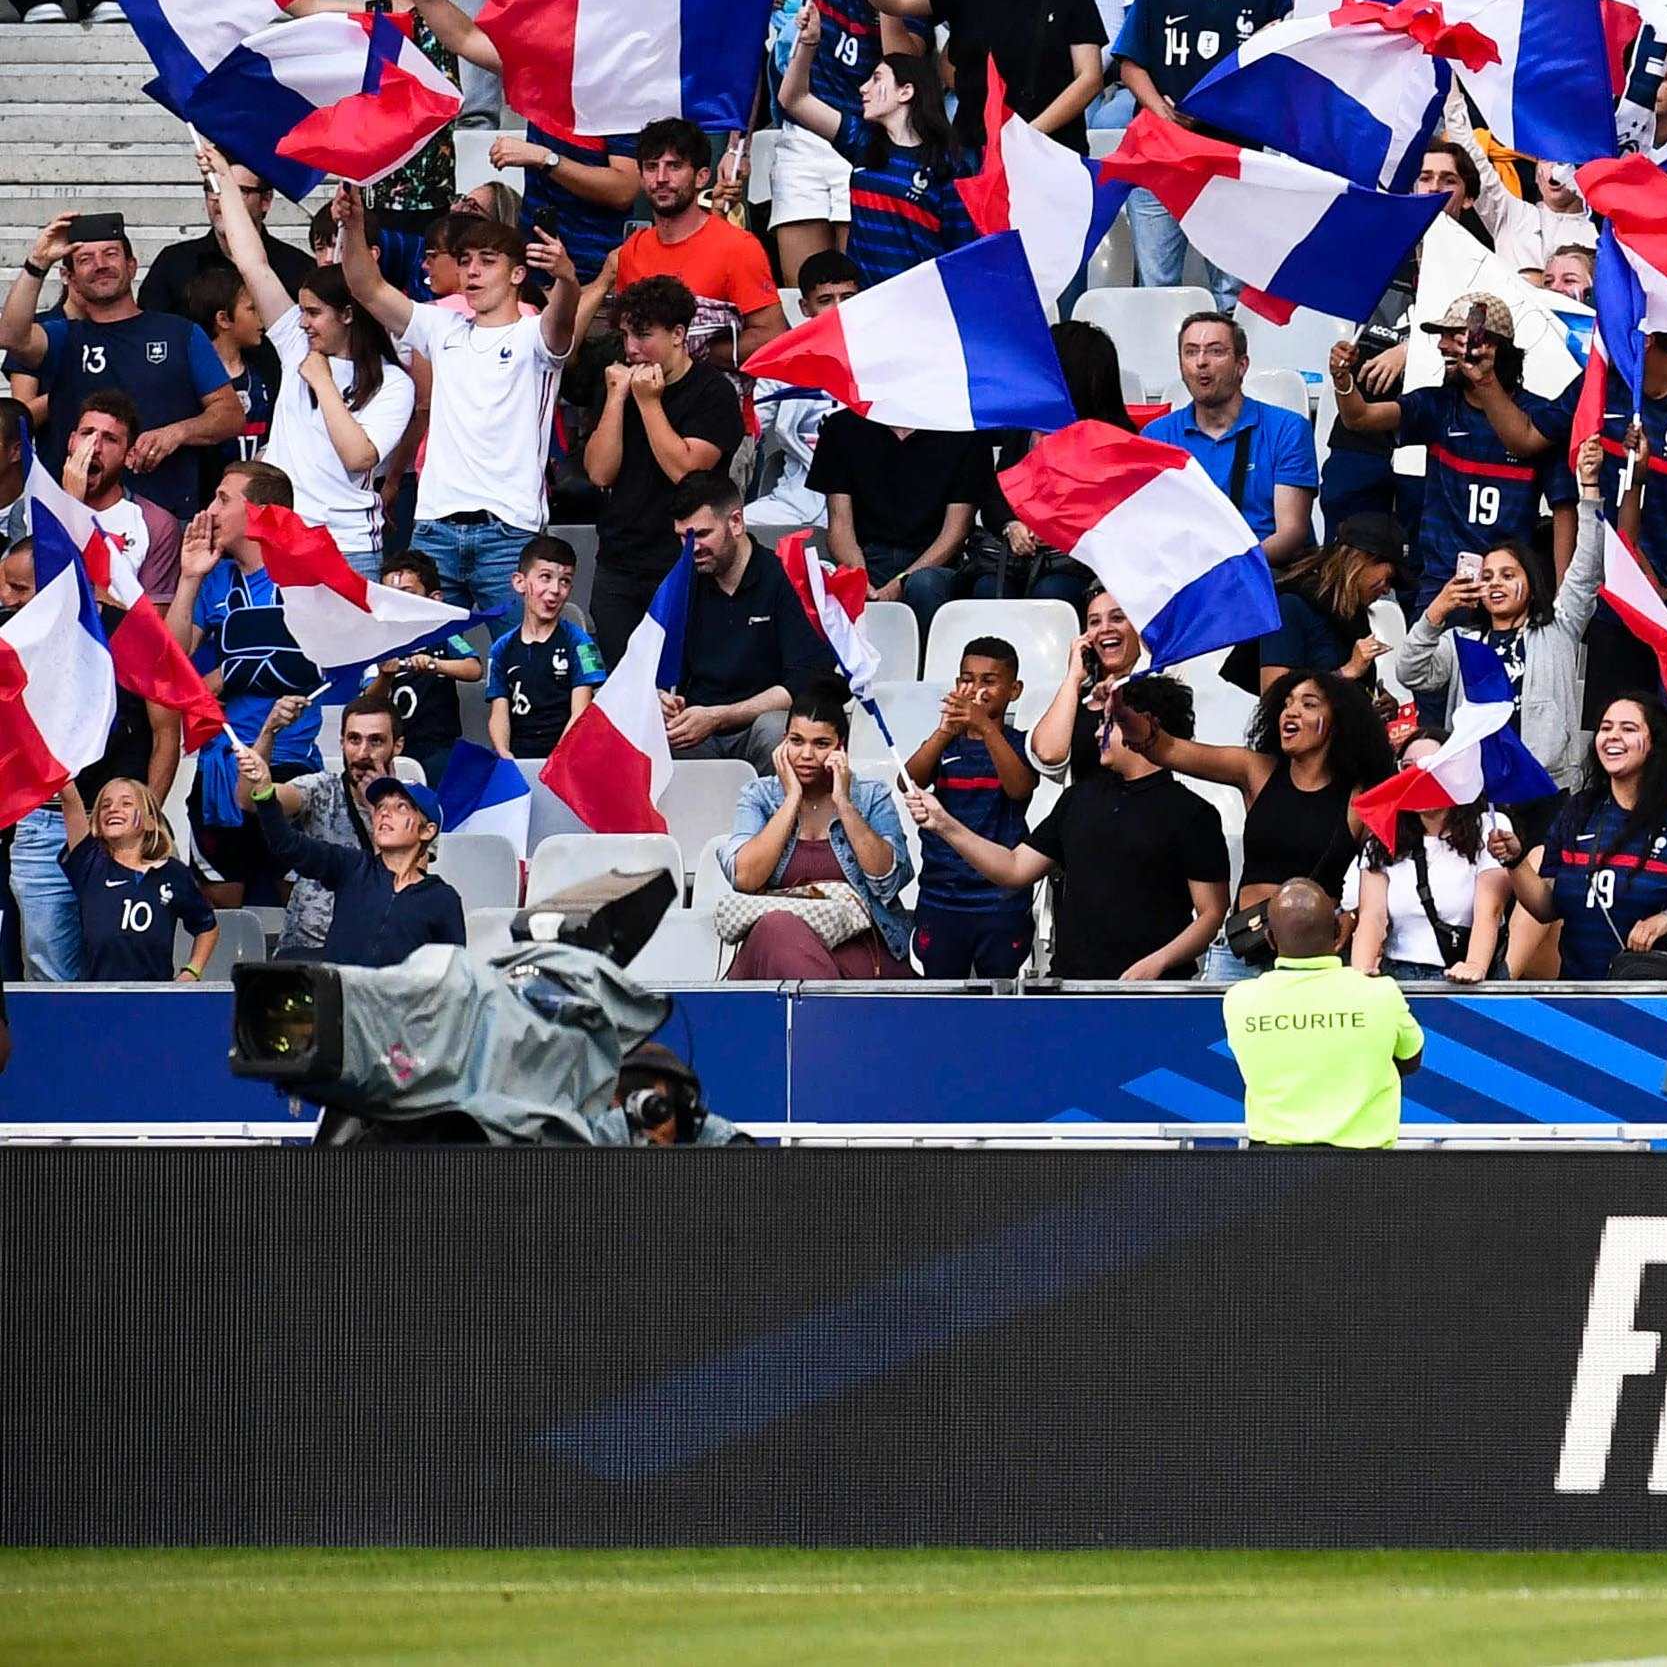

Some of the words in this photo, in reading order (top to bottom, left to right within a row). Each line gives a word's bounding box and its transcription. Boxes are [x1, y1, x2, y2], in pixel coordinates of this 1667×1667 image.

[834, 31, 858, 67] 19
[1164, 28, 1190, 66] 14
[82, 344, 107, 374] 13
[1467, 484, 1501, 527] 19
[1585, 869, 1616, 909] 19
[121, 898, 153, 933] 10
[1244, 1011, 1367, 1034] SECURITE
